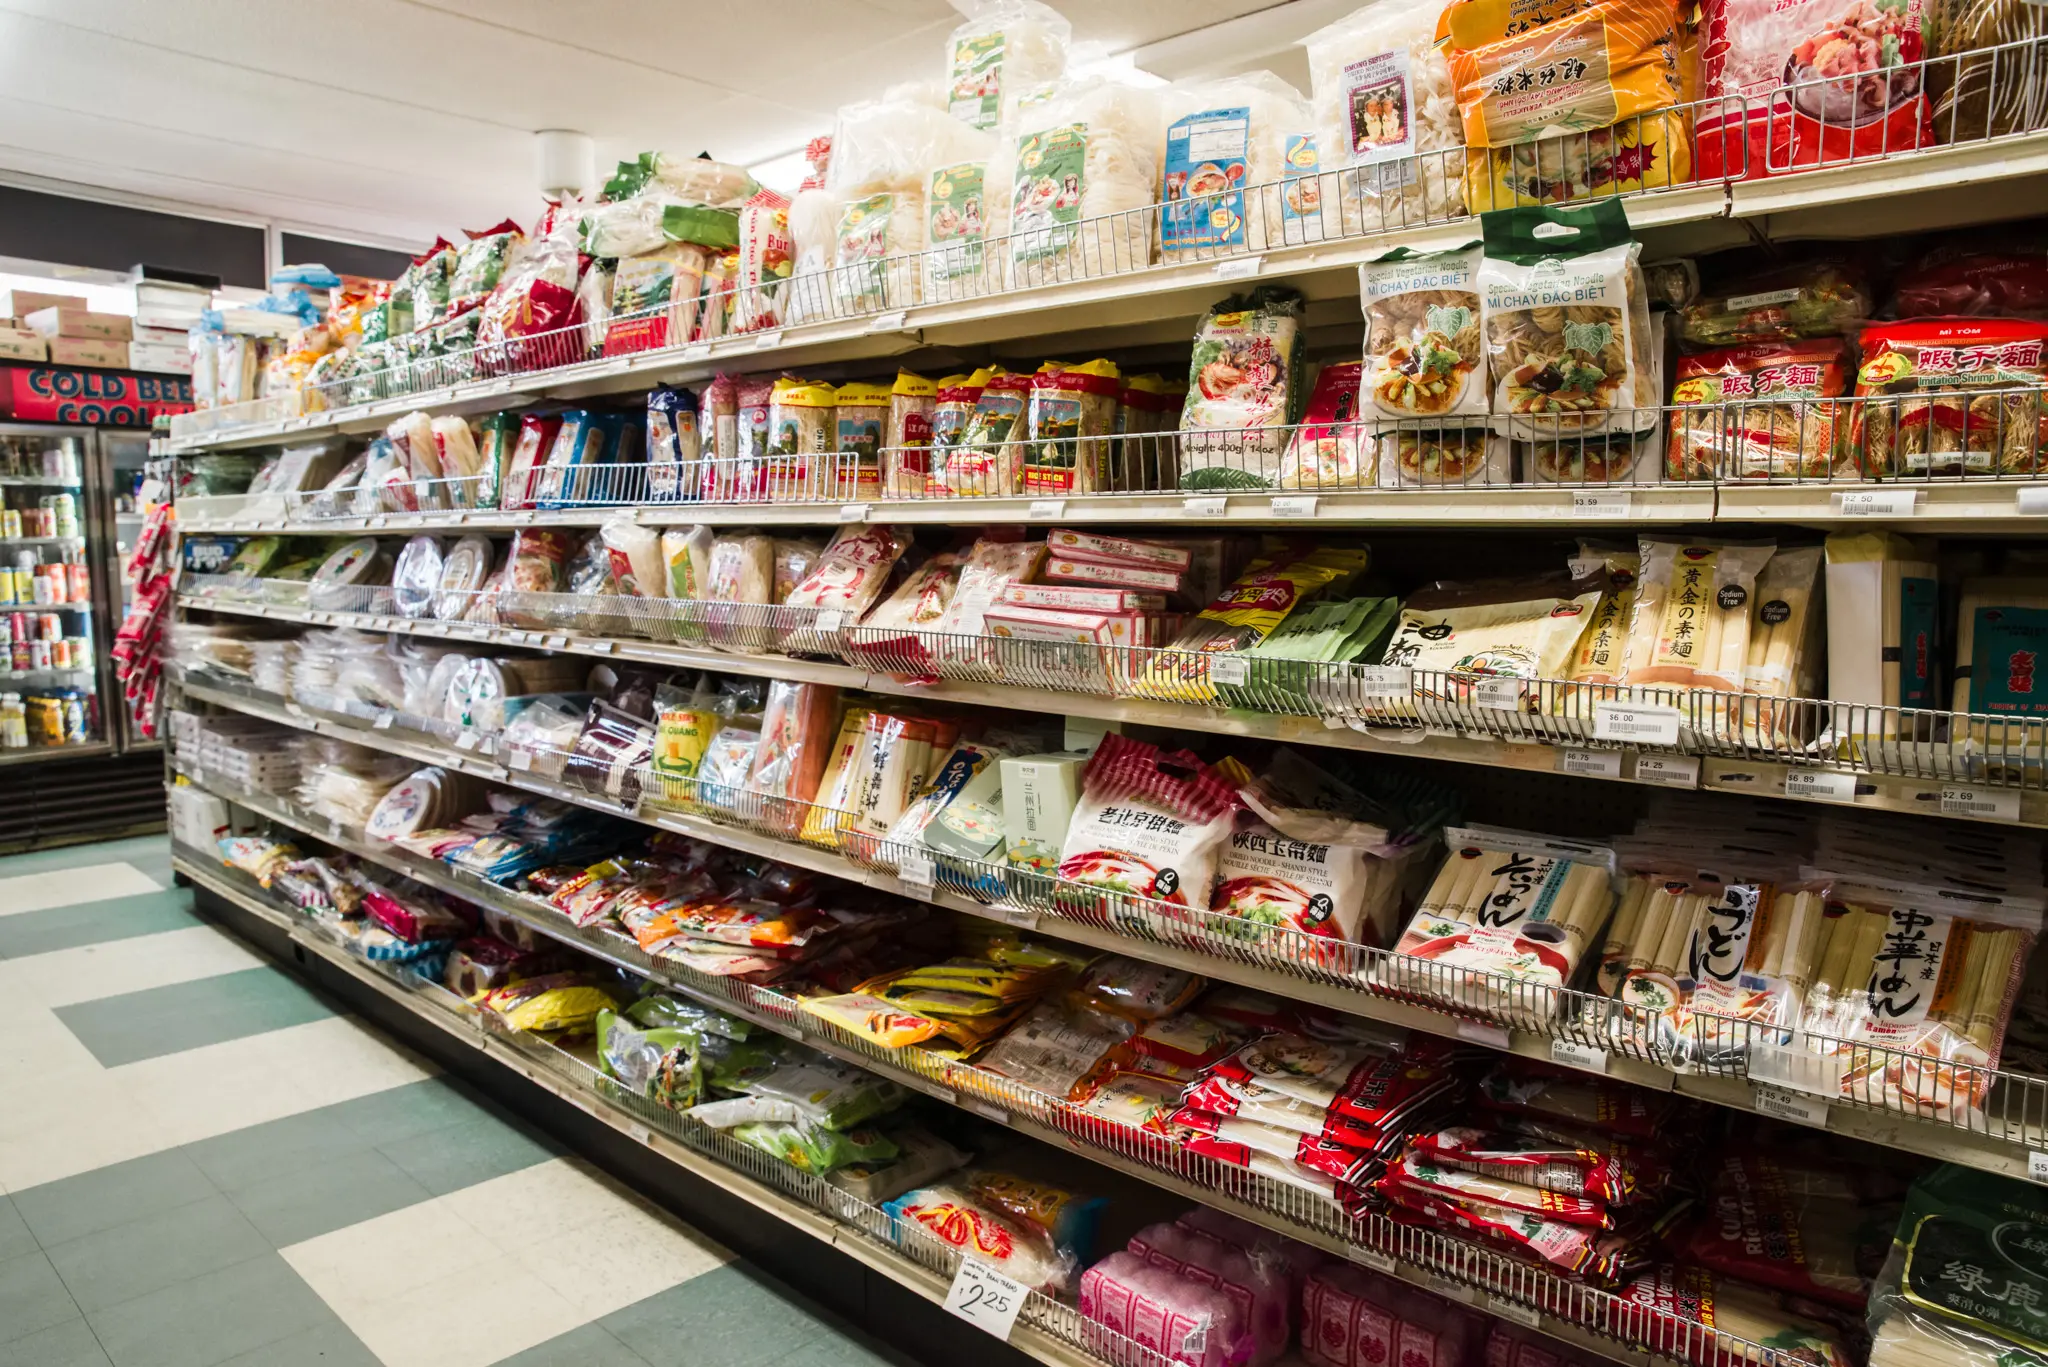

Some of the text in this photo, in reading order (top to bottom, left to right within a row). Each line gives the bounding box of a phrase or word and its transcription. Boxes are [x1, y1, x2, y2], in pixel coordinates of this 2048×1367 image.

[1368, 260, 1468, 282] Special Vegetarian Noodle
[1380, 280, 1410, 293] CHAY
[1488, 283, 1518, 296] Special
[1574, 272, 1604, 286] Noodle
[1504, 294, 1538, 307] CHAY
[1918, 371, 2036, 387] Imitation Shrimp Noodles
[29, 368, 193, 404] COLD BEE
[1783, 389, 1816, 399] Noodles
[57, 403, 152, 425] COOL
[1720, 590, 1744, 599] Sodium
[1723, 598, 1738, 606] Free
[1764, 606, 1788, 614] Sodium
[1766, 612, 1781, 621] Free
[1610, 714, 1633, 722] $6.00
[1568, 753, 1590, 761] $6.75
[1640, 760, 1663, 769] $4.25
[1788, 774, 1814, 784] $6.89
[1943, 791, 1973, 801] $2.69
[1223, 859, 1249, 870] NOUILLE
[1275, 869, 1294, 880] STYLE
[1229, 851, 1328, 878] DRIED NOODLE SHANXI STYLE
[1689, 889, 1747, 982] うどん
[1868, 908, 1934, 1019] 中華めん
[1920, 941, 1943, 981] 日本産
[1864, 1021, 1897, 1034] Ramen
[1880, 1019, 1918, 1030] Japanese
[2035, 1163, 2048, 1172] $5
